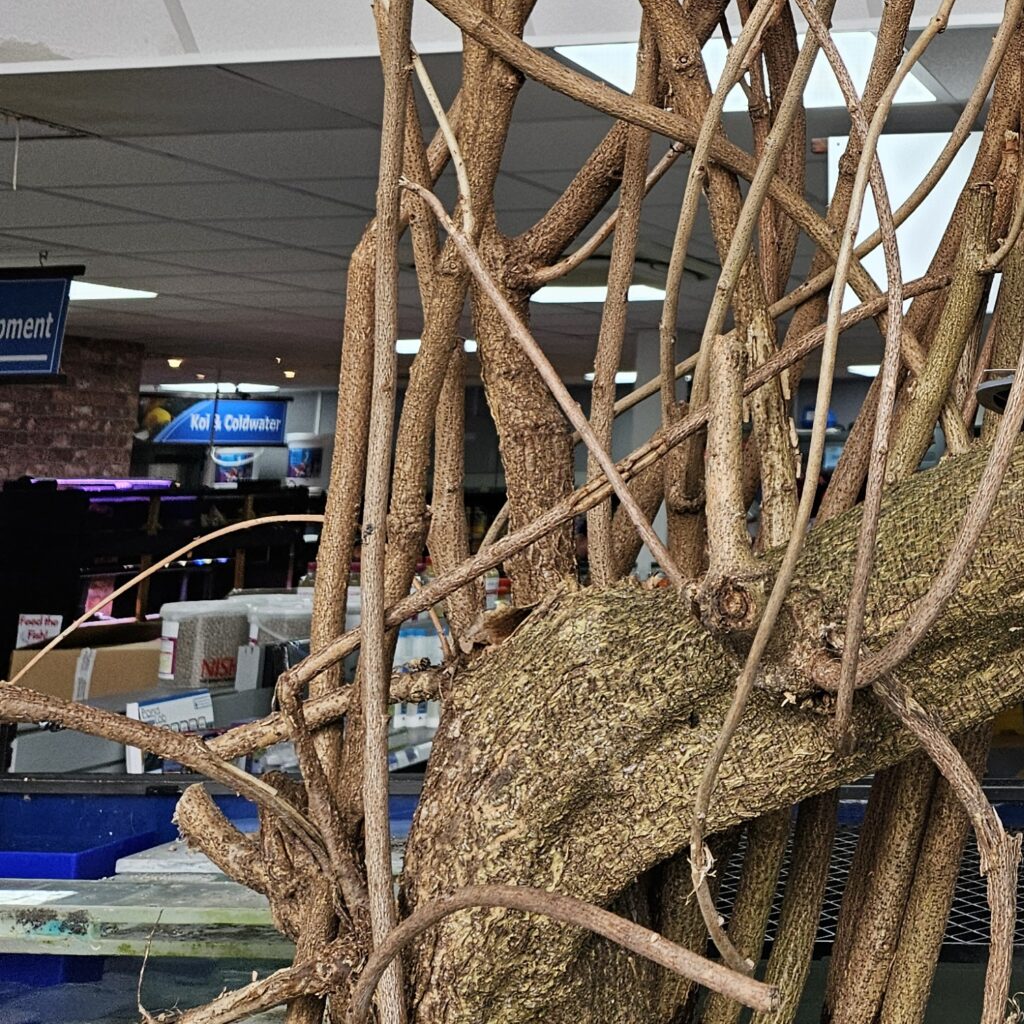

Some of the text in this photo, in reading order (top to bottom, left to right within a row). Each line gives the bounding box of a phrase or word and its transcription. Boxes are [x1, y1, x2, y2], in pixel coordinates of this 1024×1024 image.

[190, 413, 211, 431] Koi
[224, 413, 282, 432] Coldwater
[20, 616, 59, 626] Feed the
